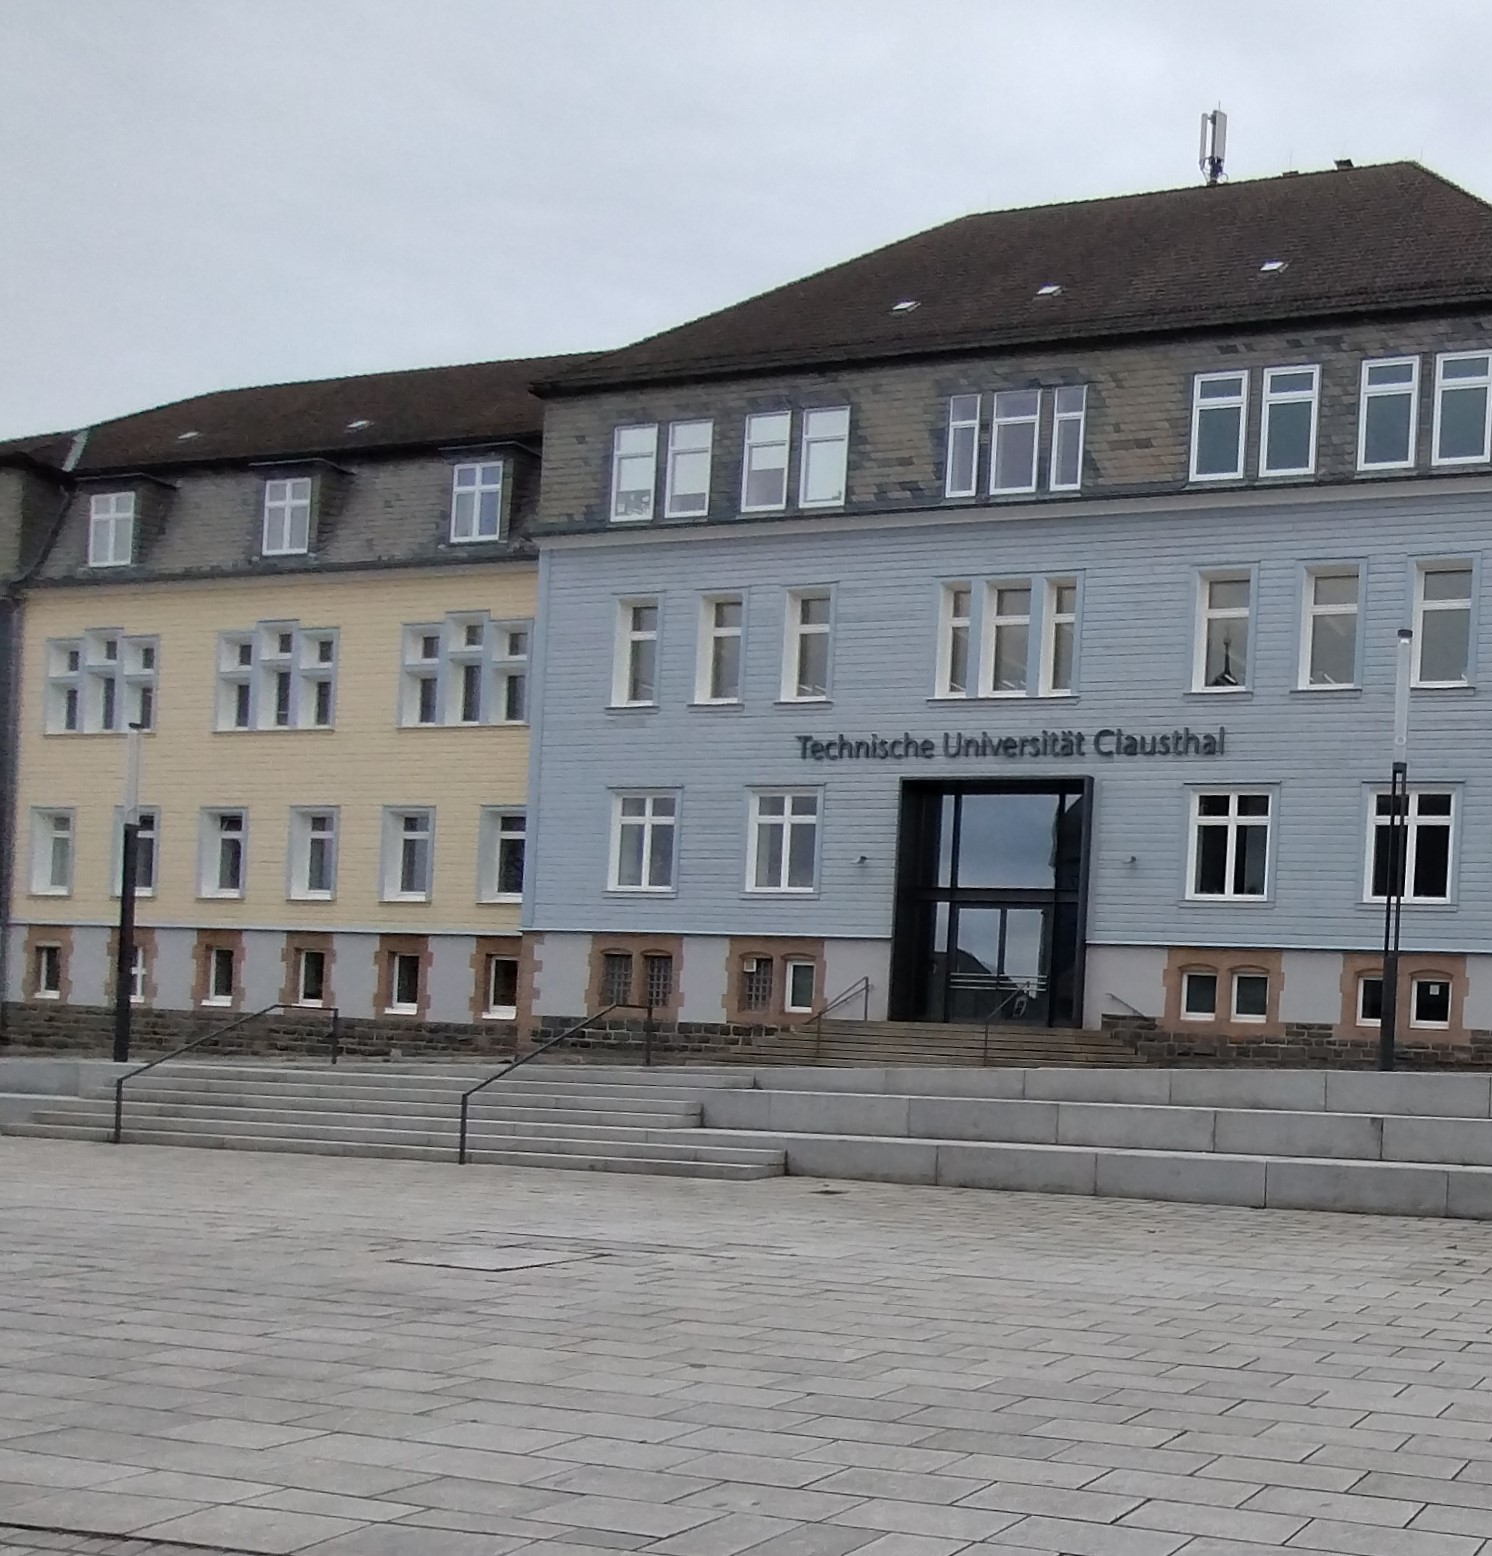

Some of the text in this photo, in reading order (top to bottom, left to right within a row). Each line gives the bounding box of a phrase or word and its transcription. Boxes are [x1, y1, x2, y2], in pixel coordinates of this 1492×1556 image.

[797, 727, 1226, 760] Technische Universität Clausthal
